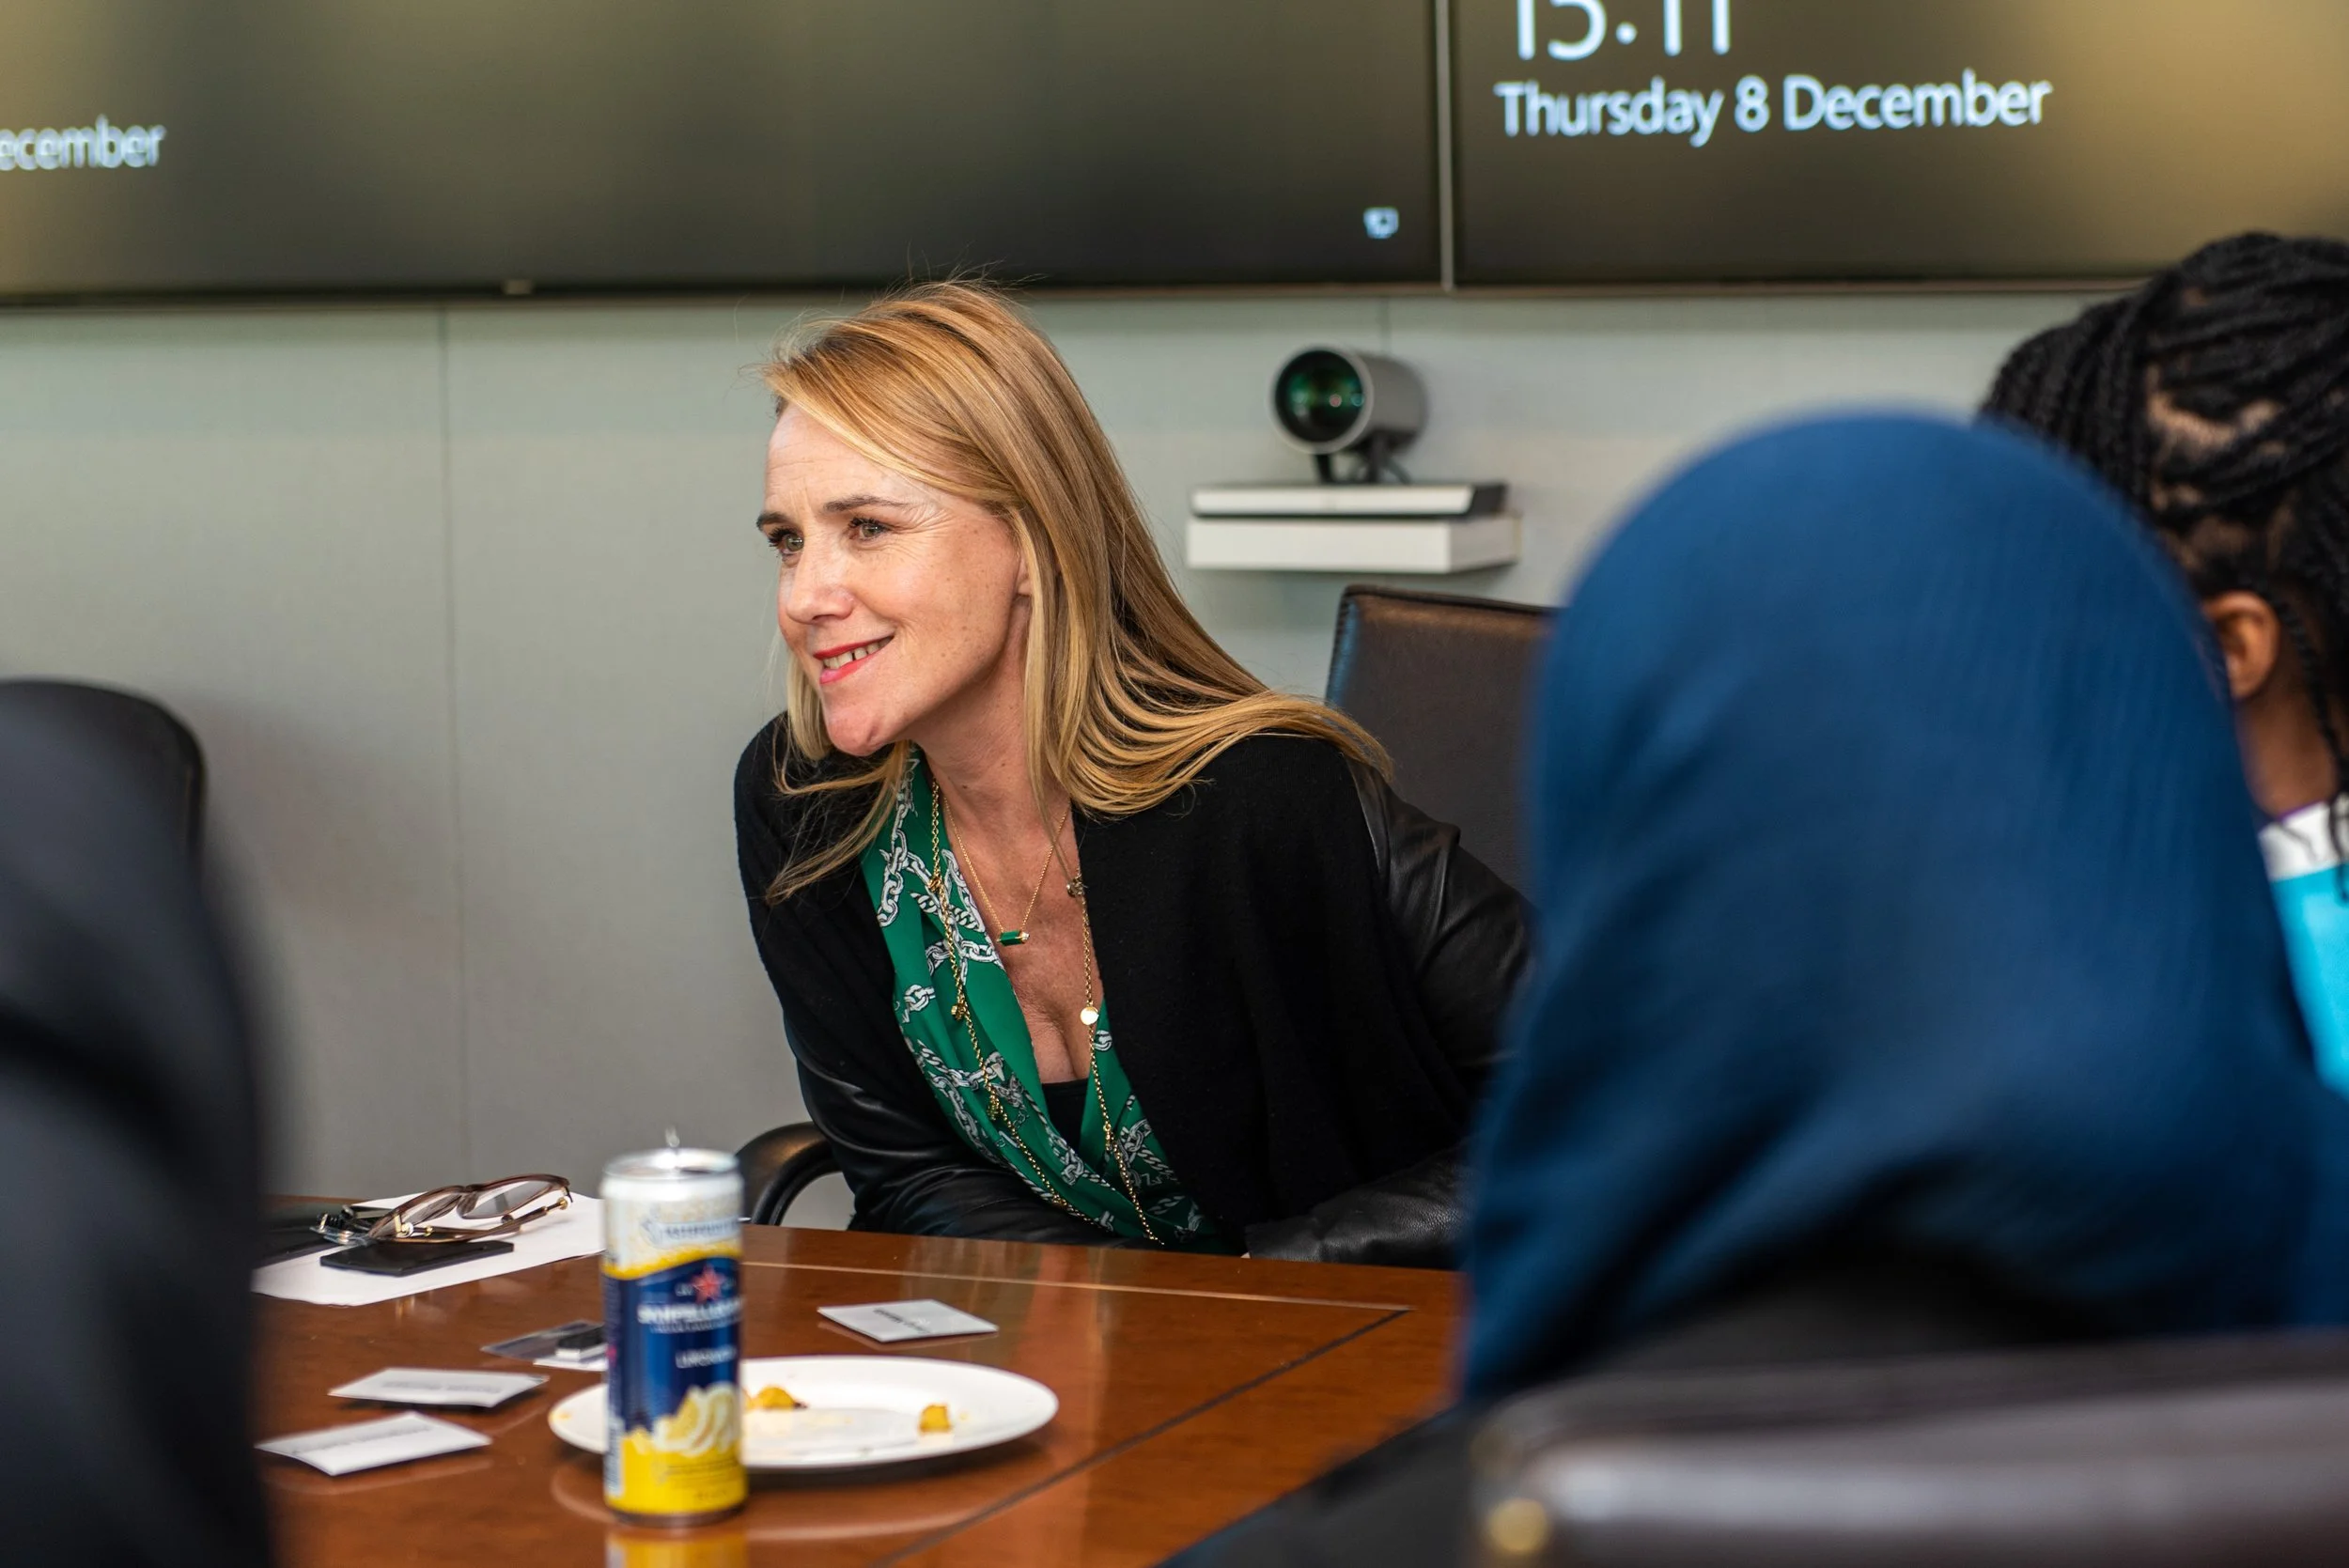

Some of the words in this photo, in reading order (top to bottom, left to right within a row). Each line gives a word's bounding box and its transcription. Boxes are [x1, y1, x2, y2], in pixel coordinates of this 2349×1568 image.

[1493, 74, 1725, 147] Thursday
[1735, 74, 1770, 132] 8
[1783, 68, 2054, 131] December
